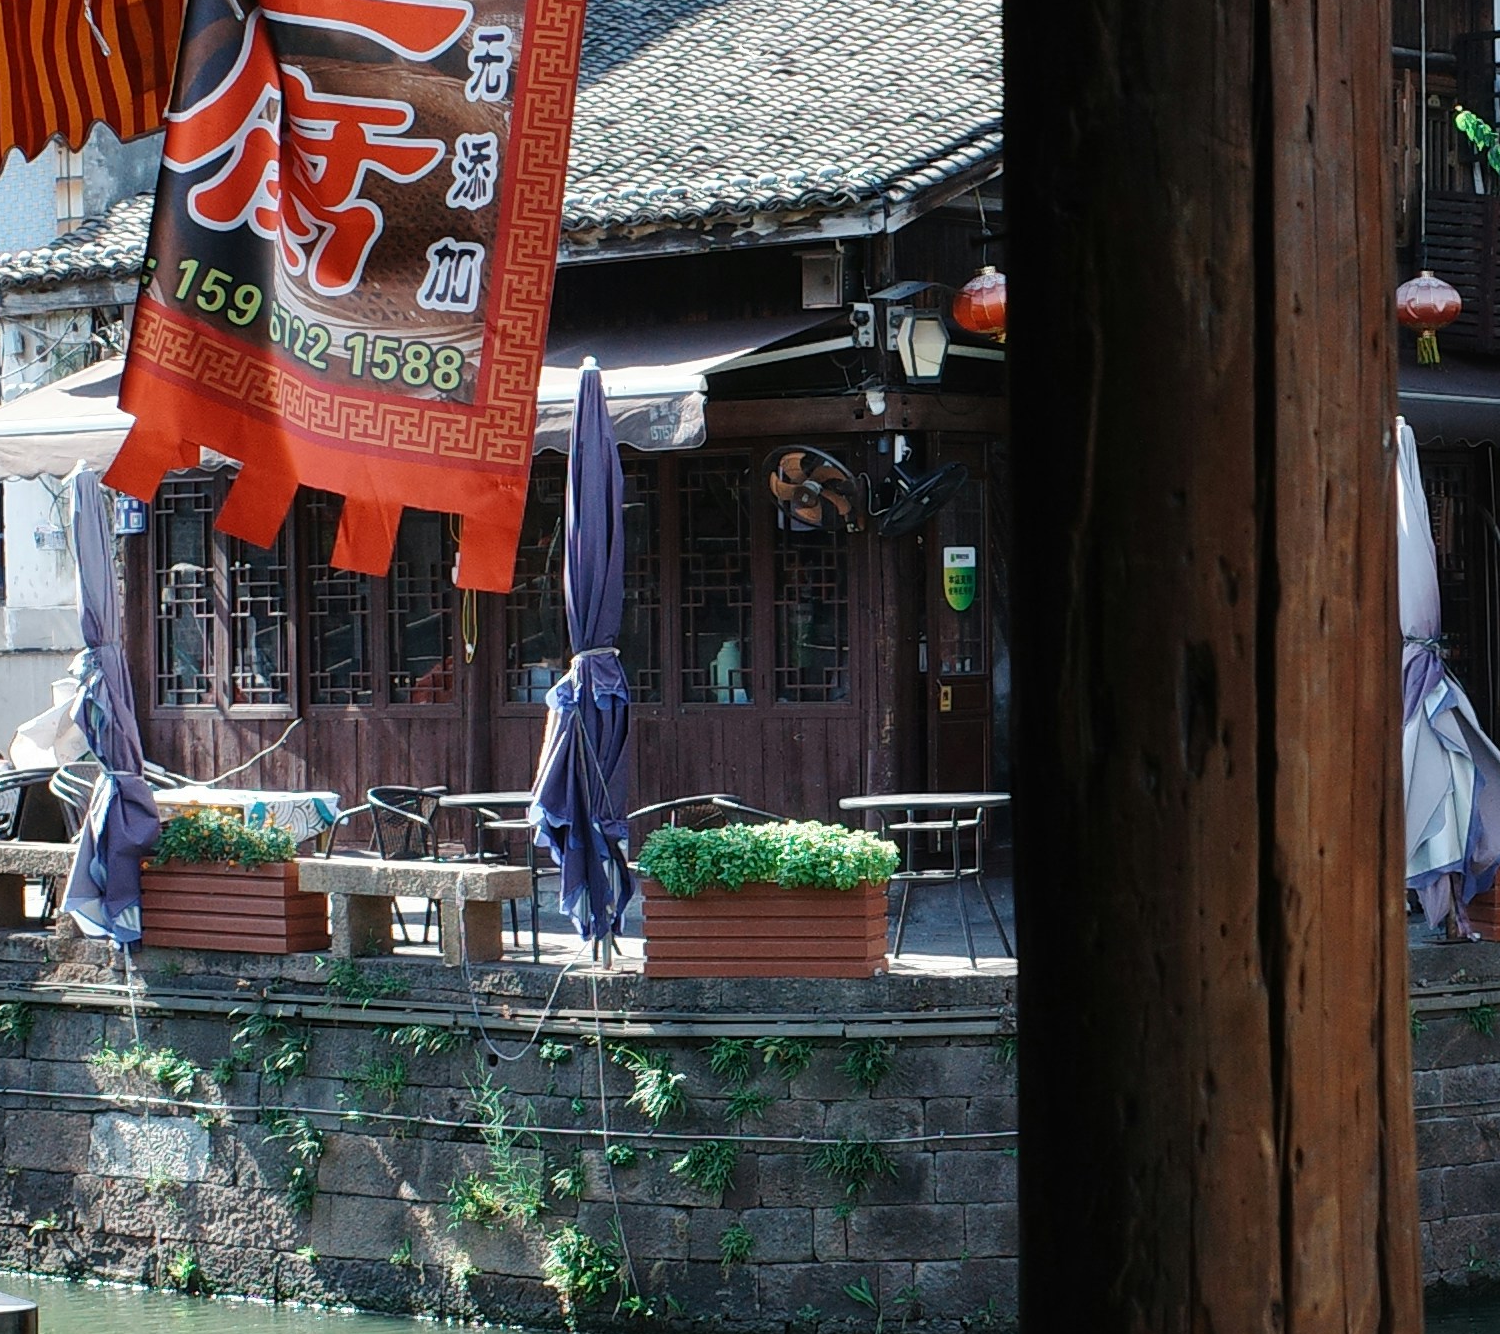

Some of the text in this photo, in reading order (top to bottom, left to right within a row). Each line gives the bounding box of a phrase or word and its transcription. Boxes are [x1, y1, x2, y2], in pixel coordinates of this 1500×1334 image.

[422, 29, 511, 307] 无添加
[175, 259, 465, 392] 159 6722 1588
